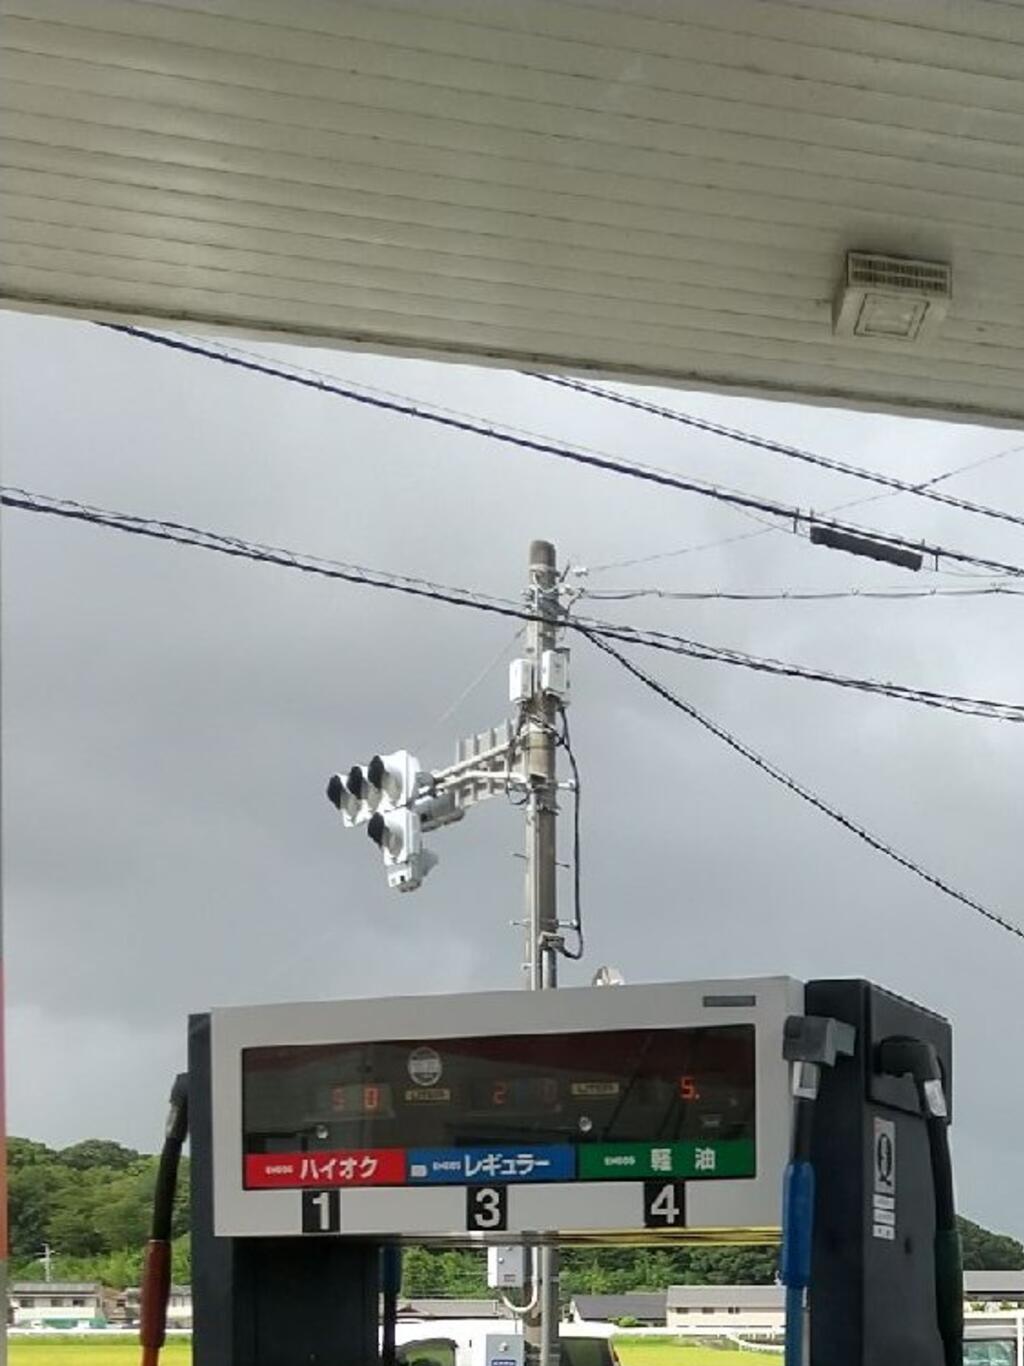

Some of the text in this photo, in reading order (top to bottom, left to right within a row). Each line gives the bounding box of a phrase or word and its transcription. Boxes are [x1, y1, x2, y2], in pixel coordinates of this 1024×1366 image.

[300, 1155, 378, 1180] ハイオク
[464, 1153, 550, 1178] レギュラー
[312, 1191, 330, 1231] 1
[474, 1188, 501, 1228] 3
[651, 1183, 680, 1225] 4
